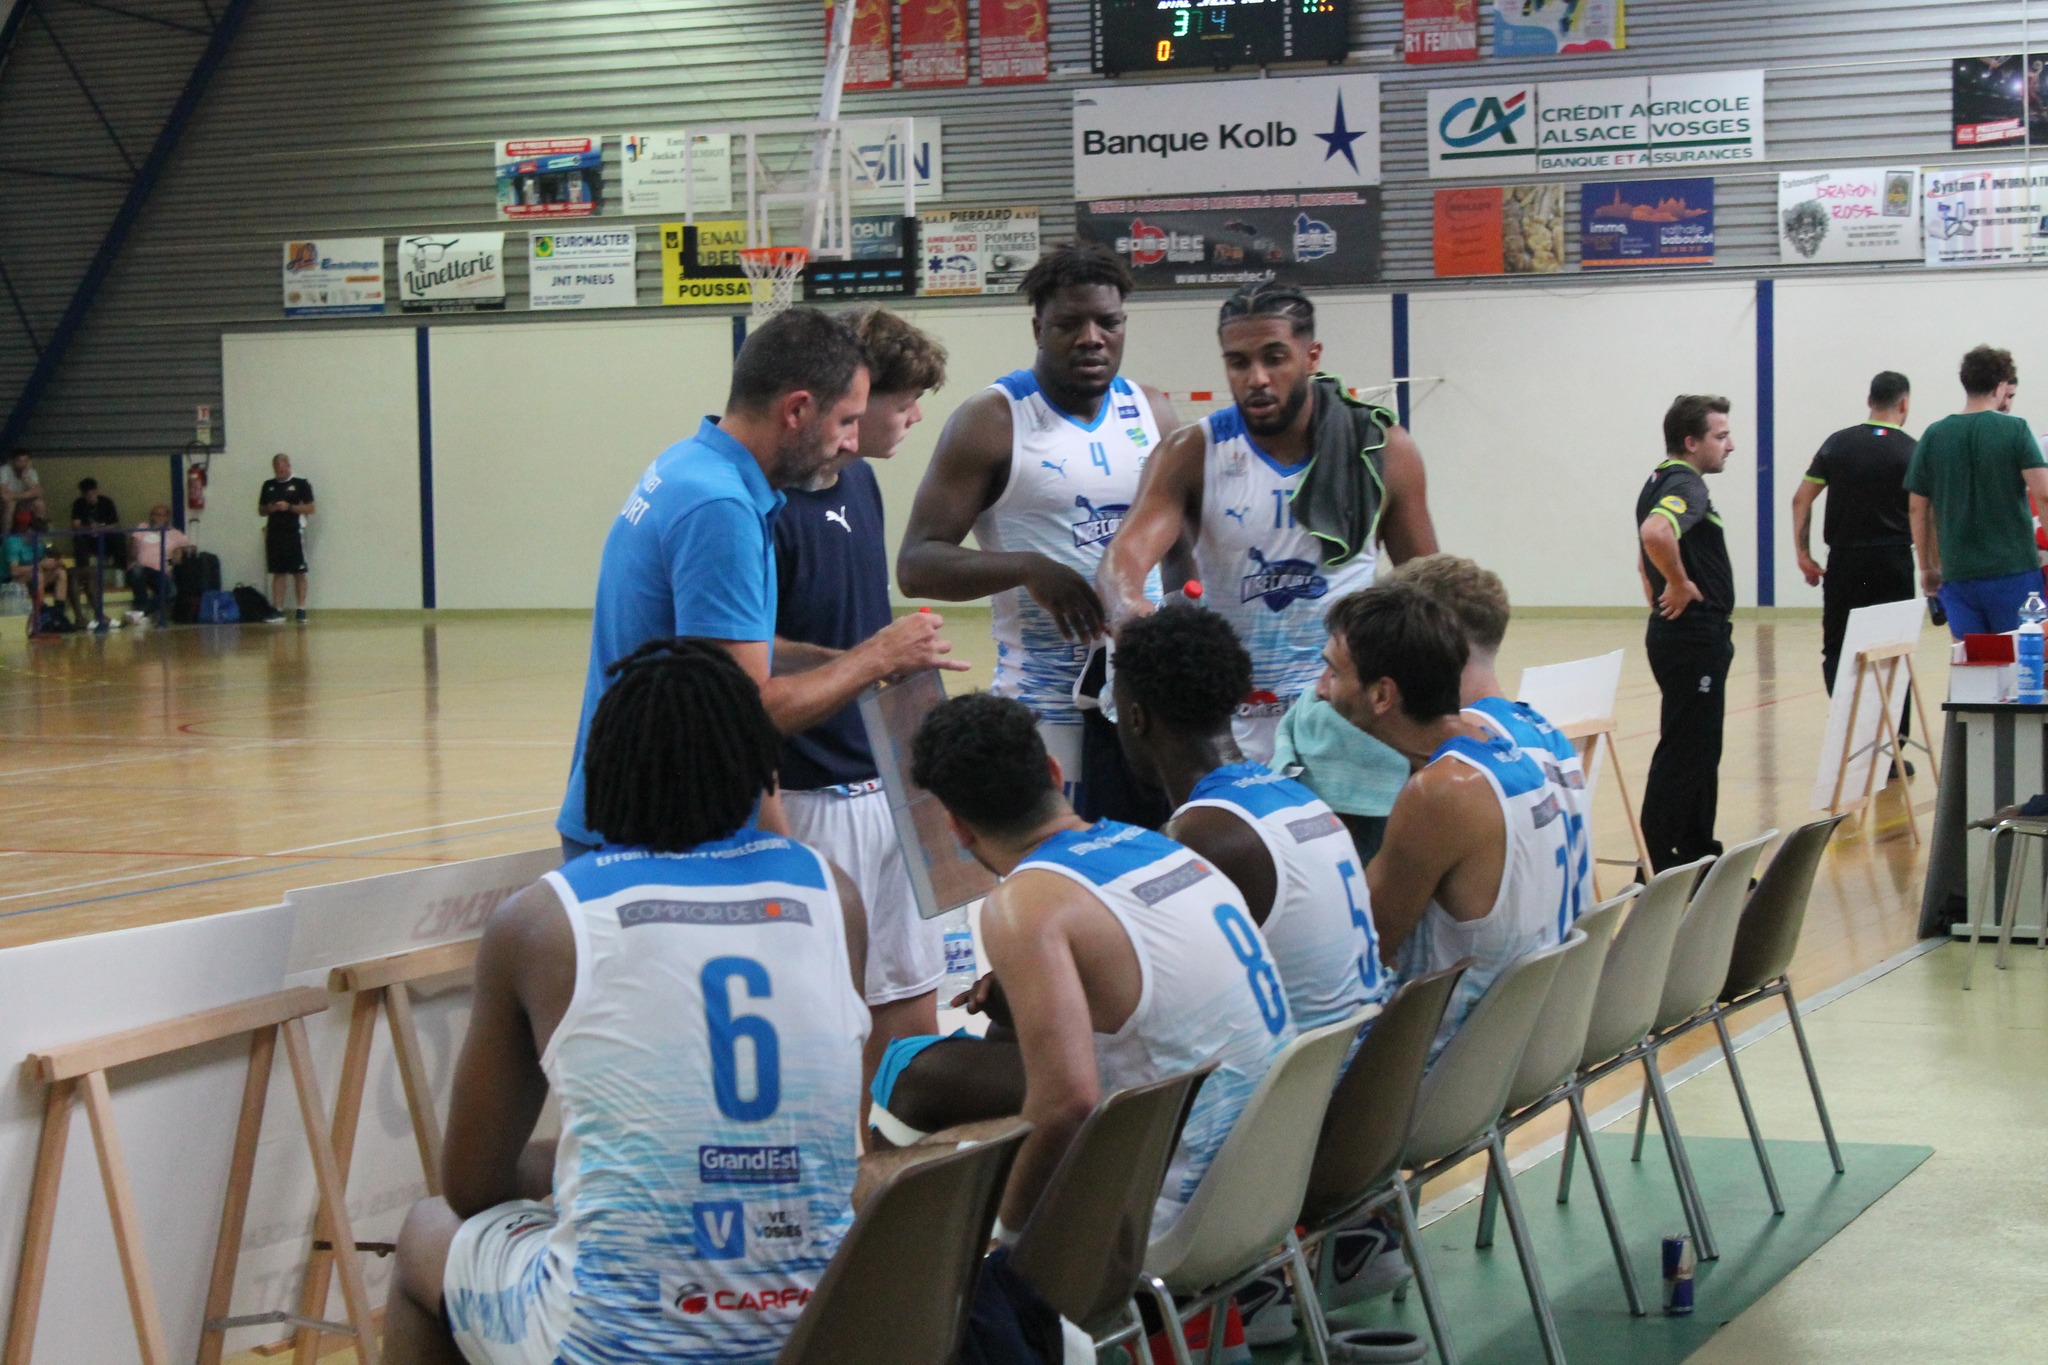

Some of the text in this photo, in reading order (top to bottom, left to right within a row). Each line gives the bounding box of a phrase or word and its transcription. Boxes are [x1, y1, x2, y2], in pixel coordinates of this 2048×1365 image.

[1541, 97, 1750, 123] CRÉDIT AGRICOLE
[1083, 121, 1298, 158] Banque Kolb
[1542, 118, 1751, 144] ALSACE VOSGES
[1541, 148, 1753, 169] BANQUE ET ASSURANCES
[1832, 204, 1880, 219] ROSE
[555, 233, 630, 249] EUROMASTER
[926, 234, 977, 243] AMBULANCE
[953, 243, 978, 253] TAXI
[985, 232, 1037, 244] POMPES
[404, 251, 495, 297] Lunetterie
[575, 274, 616, 286] PNEUS
[1089, 441, 1111, 477] 4
[1336, 859, 1377, 989] 5
[1213, 903, 1287, 1036] 8
[701, 955, 780, 1123] 6
[702, 1148, 799, 1170] GrandEst
